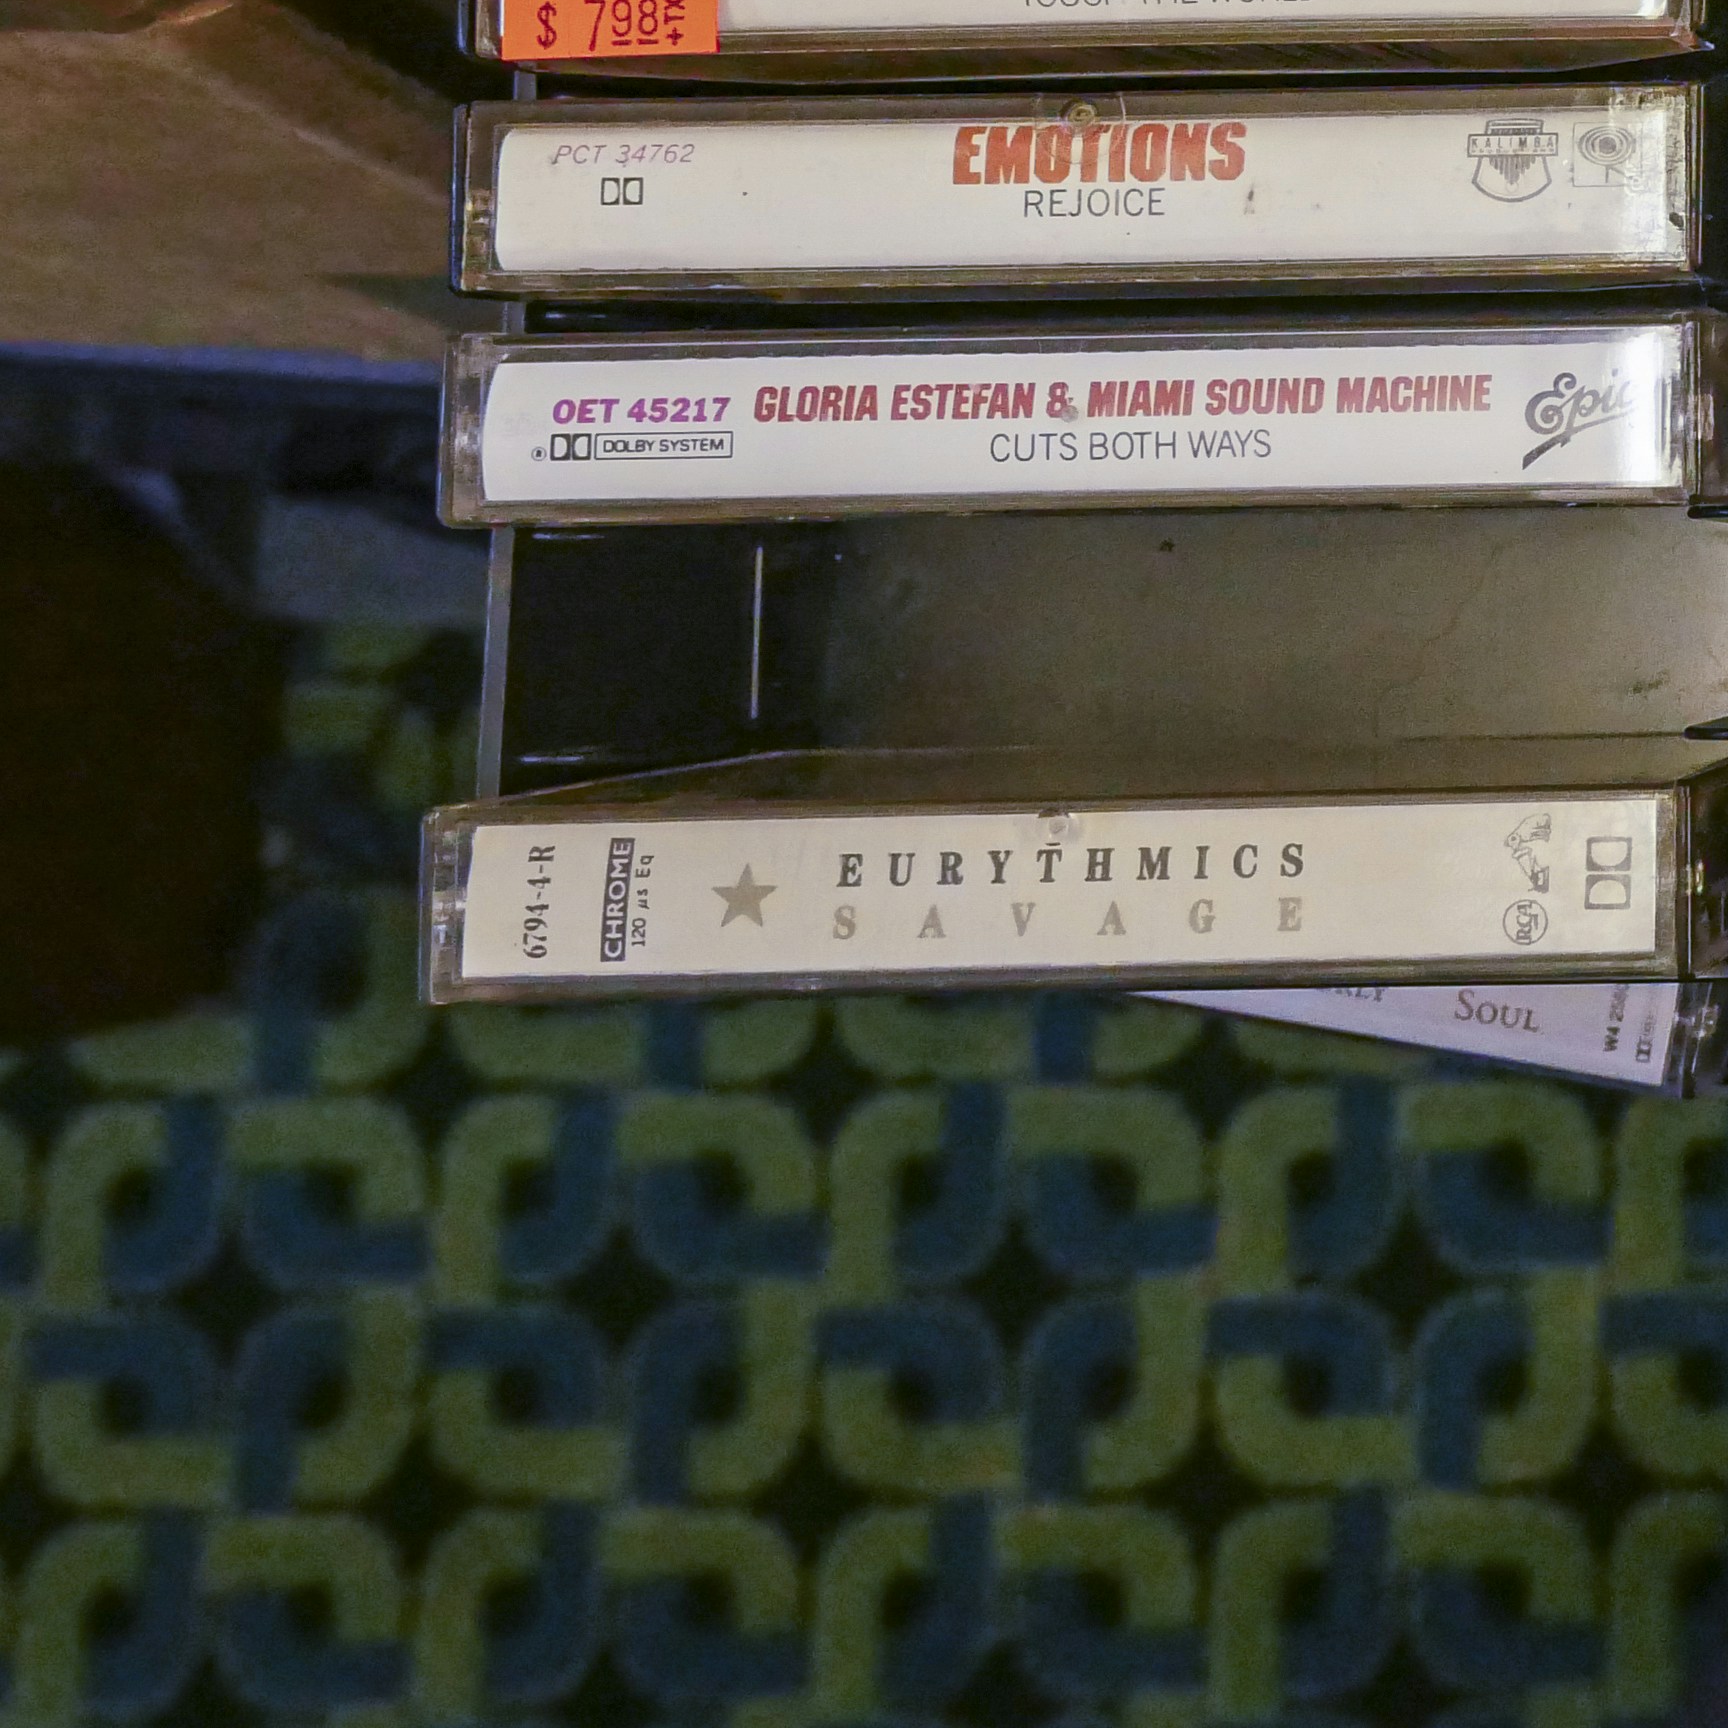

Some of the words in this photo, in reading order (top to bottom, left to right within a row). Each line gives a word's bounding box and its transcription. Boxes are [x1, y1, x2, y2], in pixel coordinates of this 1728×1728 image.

[953, 121, 1248, 186] EMOTIONS
[1024, 187, 1166, 218] REJOICE
[552, 397, 620, 423] OET
[627, 395, 732, 423] 45217
[754, 384, 880, 423] GLORIA
[891, 381, 1039, 422] ESTEFAN
[1047, 380, 1074, 419] &
[1088, 377, 1195, 418] MIAMI
[1205, 375, 1325, 415] SOUND
[1335, 373, 1494, 413] MACHINE
[836, 842, 1305, 887] EURYTHMICS
[603, 839, 636, 960] CHROME
[832, 896, 1304, 940] SAVAGE
